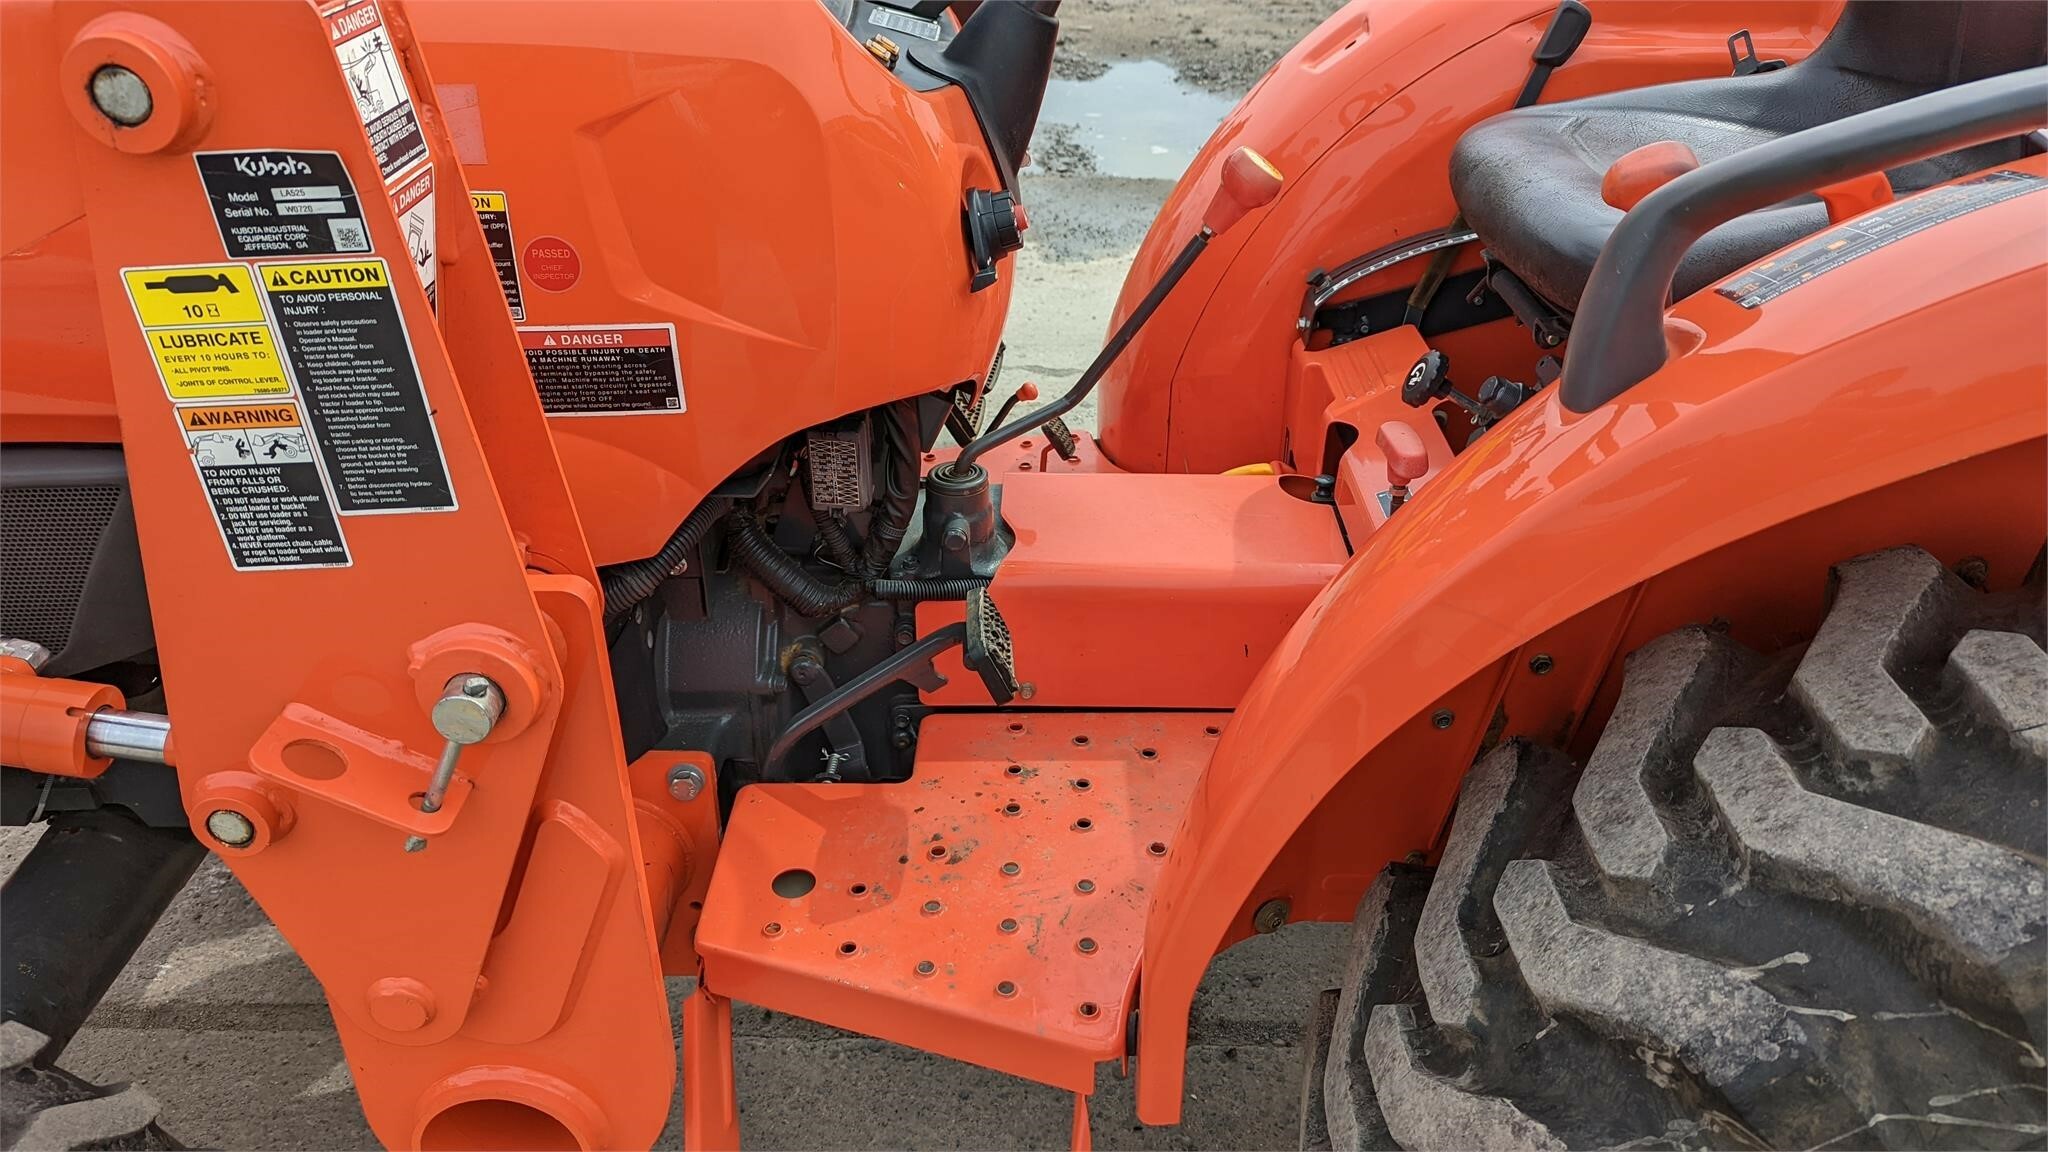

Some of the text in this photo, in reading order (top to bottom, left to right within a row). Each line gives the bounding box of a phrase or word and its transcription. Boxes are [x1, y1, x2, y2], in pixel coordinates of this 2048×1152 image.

[338, 5, 378, 36] DANGER
[234, 156, 312, 177] Kubota
[228, 189, 305, 202] Model LA525
[400, 175, 430, 209] DANGER
[224, 205, 314, 218] Serial No. W0720
[231, 224, 308, 234] KUBOTA INDUSTRIAL
[238, 234, 283, 242] EQUIPMENT
[244, 241, 308, 250] JEFFERSON, GA
[532, 249, 570, 258] PASSED
[290, 268, 380, 284] CAUTION
[279, 292, 382, 304] TO AVOID PERSONAL
[183, 304, 203, 318] 10
[284, 306, 318, 315] INJURY
[340, 318, 377, 326] precautions
[159, 332, 264, 349] LUBRICATE
[561, 334, 624, 345] DANGER
[164, 351, 270, 364] EVERY 10 HOURS TO:
[205, 409, 293, 425] WARNING
[204, 467, 280, 478] TO AVOID INJURY
[208, 476, 281, 486] FROM FALLS OR
[211, 485, 290, 496] BEING CRUSHED:
